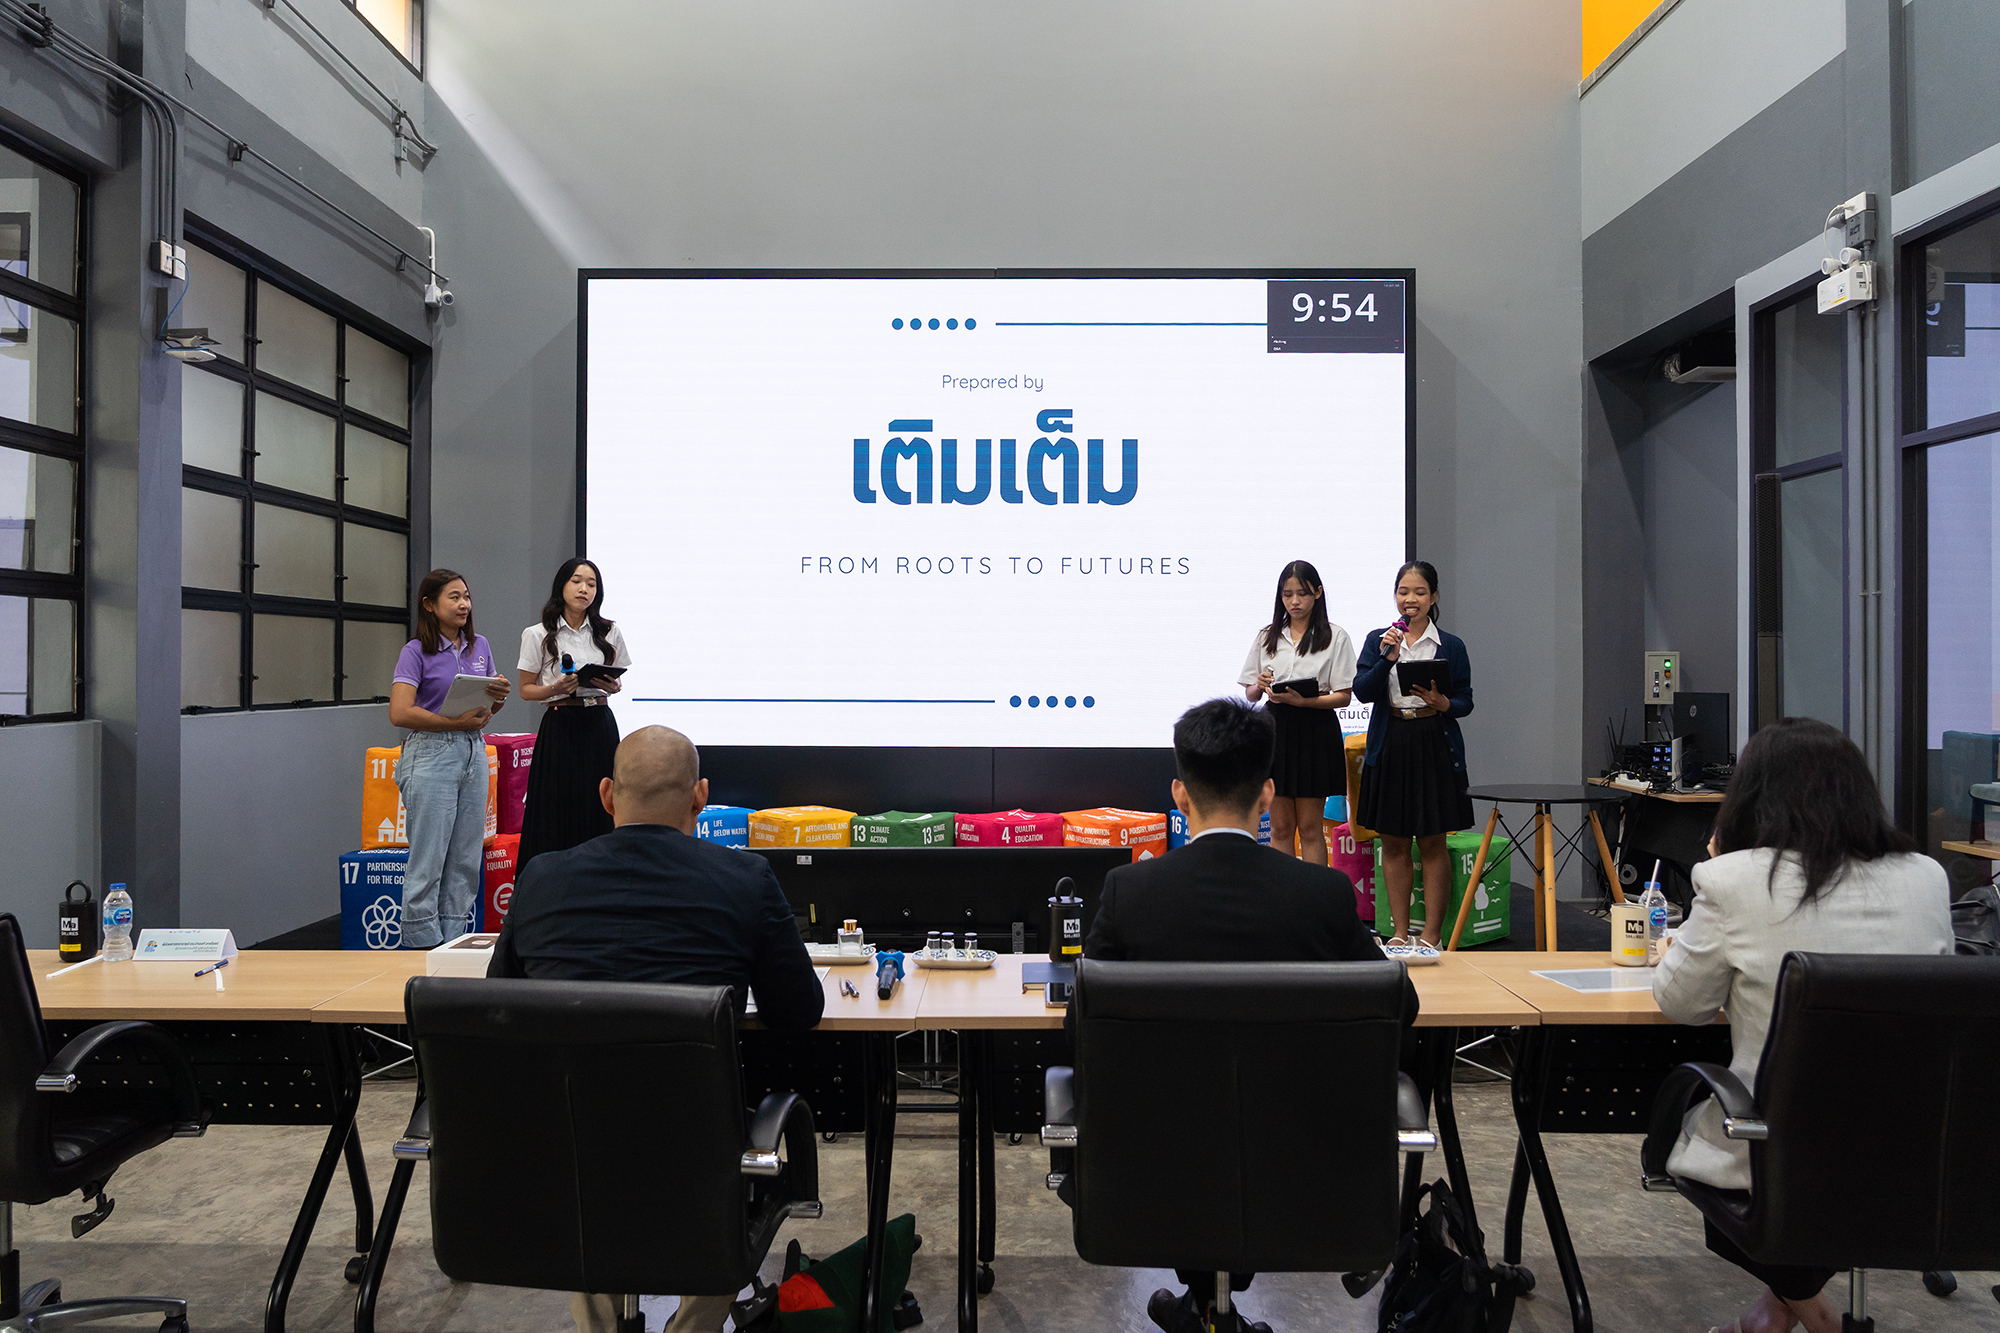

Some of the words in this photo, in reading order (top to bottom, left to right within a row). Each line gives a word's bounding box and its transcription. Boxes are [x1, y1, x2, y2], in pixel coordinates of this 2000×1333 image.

[1292, 292, 1378, 322] 9:54
[942, 374, 1018, 392] Prepared
[1024, 374, 1044, 392] by
[854, 409, 1138, 505] เติมเต็ม
[802, 556, 877, 575] FROM
[897, 556, 991, 575] ROOTS
[1009, 556, 1042, 575] TO
[1062, 556, 1190, 575] FUTURES
[1339, 706, 1370, 720] ติมเต็
[513, 749, 519, 768] 8
[371, 758, 386, 779] 11
[696, 822, 710, 838] 14
[713, 820, 723, 828] LIFE
[714, 829, 730, 837] BELOW
[731, 828, 747, 836] WATER
[805, 824, 838, 832] AFFORDABLE
[838, 822, 848, 830] AND
[852, 824, 866, 842] 13
[870, 826, 890, 834] CLIMATE
[1014, 824, 1036, 834] QUALITY
[1171, 816, 1182, 834] 16
[793, 826, 801, 844] 7
[806, 835, 822, 843] CLEAN
[822, 832, 842, 841] ENERGY
[870, 836, 888, 844] ACTION
[922, 826, 932, 844] 13
[1001, 826, 1010, 844] 4
[1014, 834, 1044, 843] EDUCATION
[1120, 828, 1128, 846] 9
[486, 848, 507, 860] GENDER
[1338, 836, 1356, 854] 10
[1376, 846, 1382, 866] 1
[1461, 853, 1474, 875] 15
[342, 862, 360, 884] 17
[486, 860, 512, 872] EQUALITY
[367, 875, 380, 884] FOR
[382, 875, 393, 884] THE
[394, 875, 405, 885] GO
